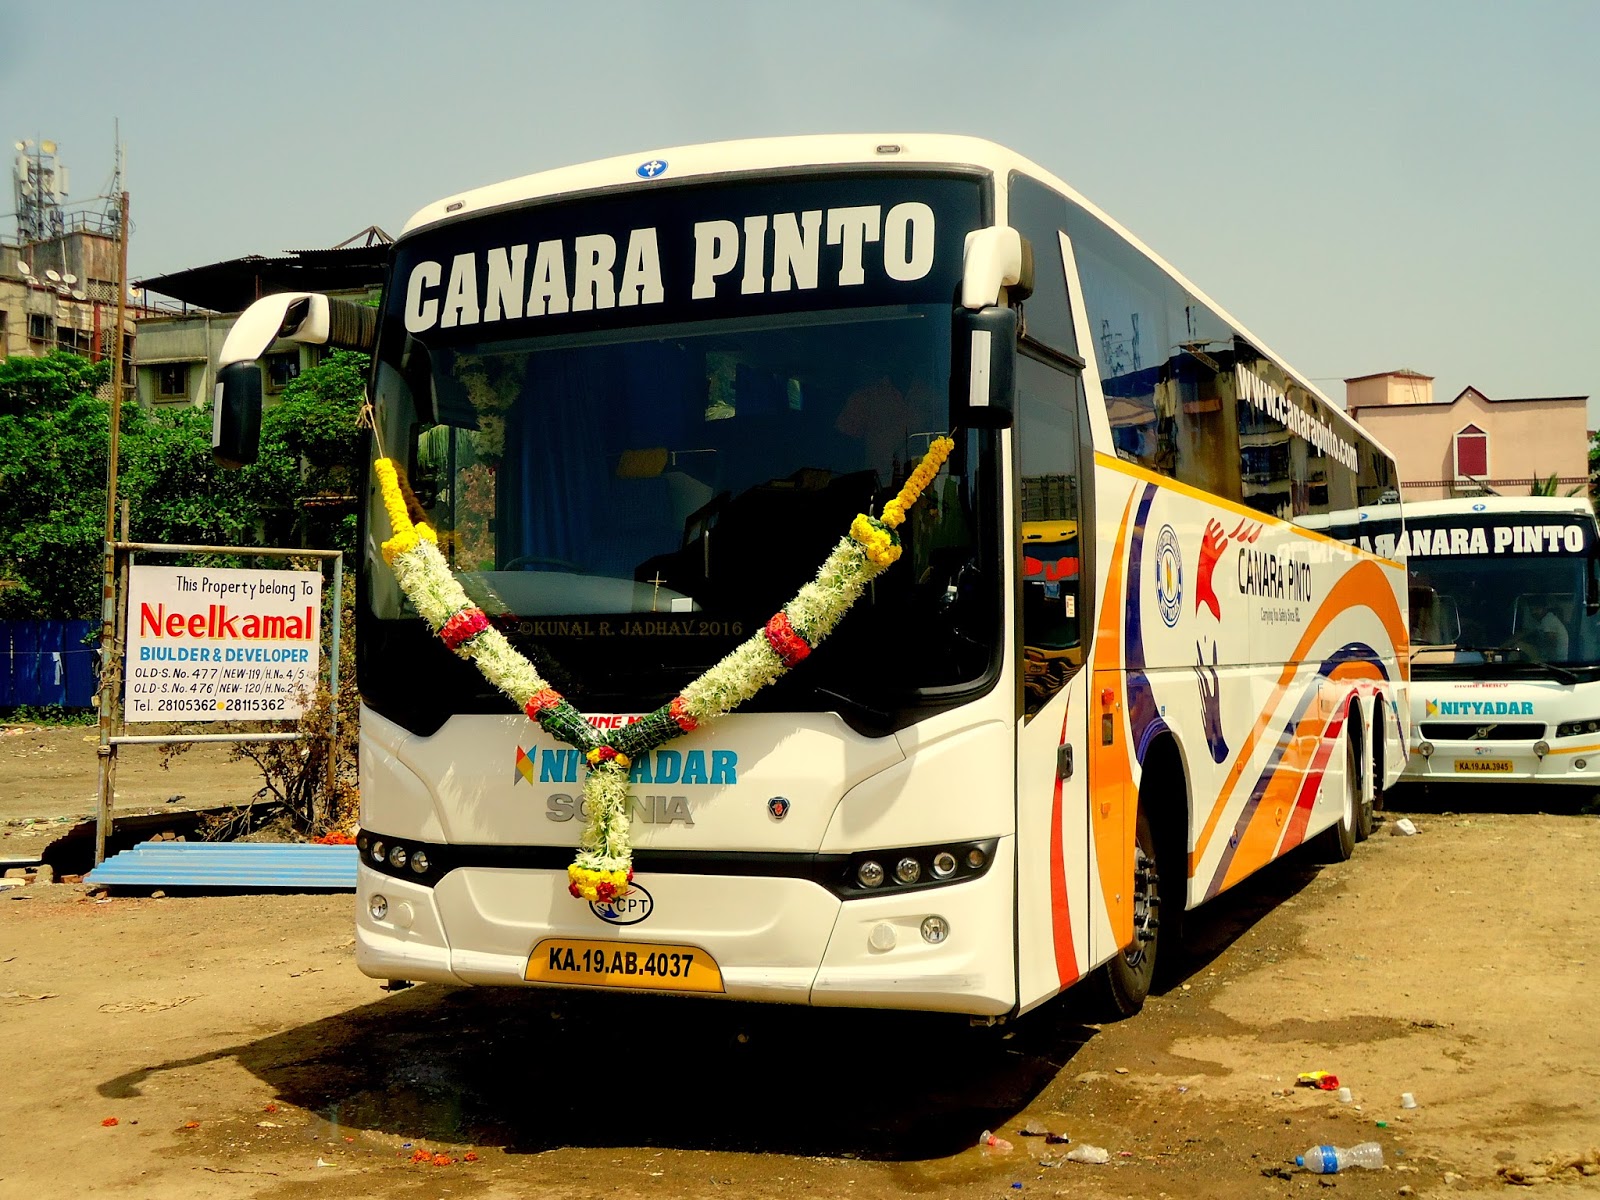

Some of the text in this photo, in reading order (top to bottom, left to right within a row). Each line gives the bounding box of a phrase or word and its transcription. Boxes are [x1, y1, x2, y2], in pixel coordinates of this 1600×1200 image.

[404, 201, 936, 333] CANARA PINTO
[1236, 363, 1359, 474] www.canarapinto.com
[1403, 525, 1584, 557] ANARA PINTO
[176, 575, 314, 602] This Property belong To
[1238, 547, 1285, 600] CANARA
[1288, 558, 1312, 603] PINTO
[140, 602, 314, 641] Neelkamal
[140, 647, 309, 663] BIULDER & DEVELOPER
[171, 683, 188, 693] No.
[172, 668, 189, 679] No.
[134, 699, 285, 711] Tel. 28105362 28115362
[1440, 701, 1534, 716] NITYADAR
[539, 749, 738, 785] NIADAR
[545, 793, 695, 825] SCNIA
[616, 898, 648, 913] CPT
[549, 946, 695, 978] KA.19.AB.4037
